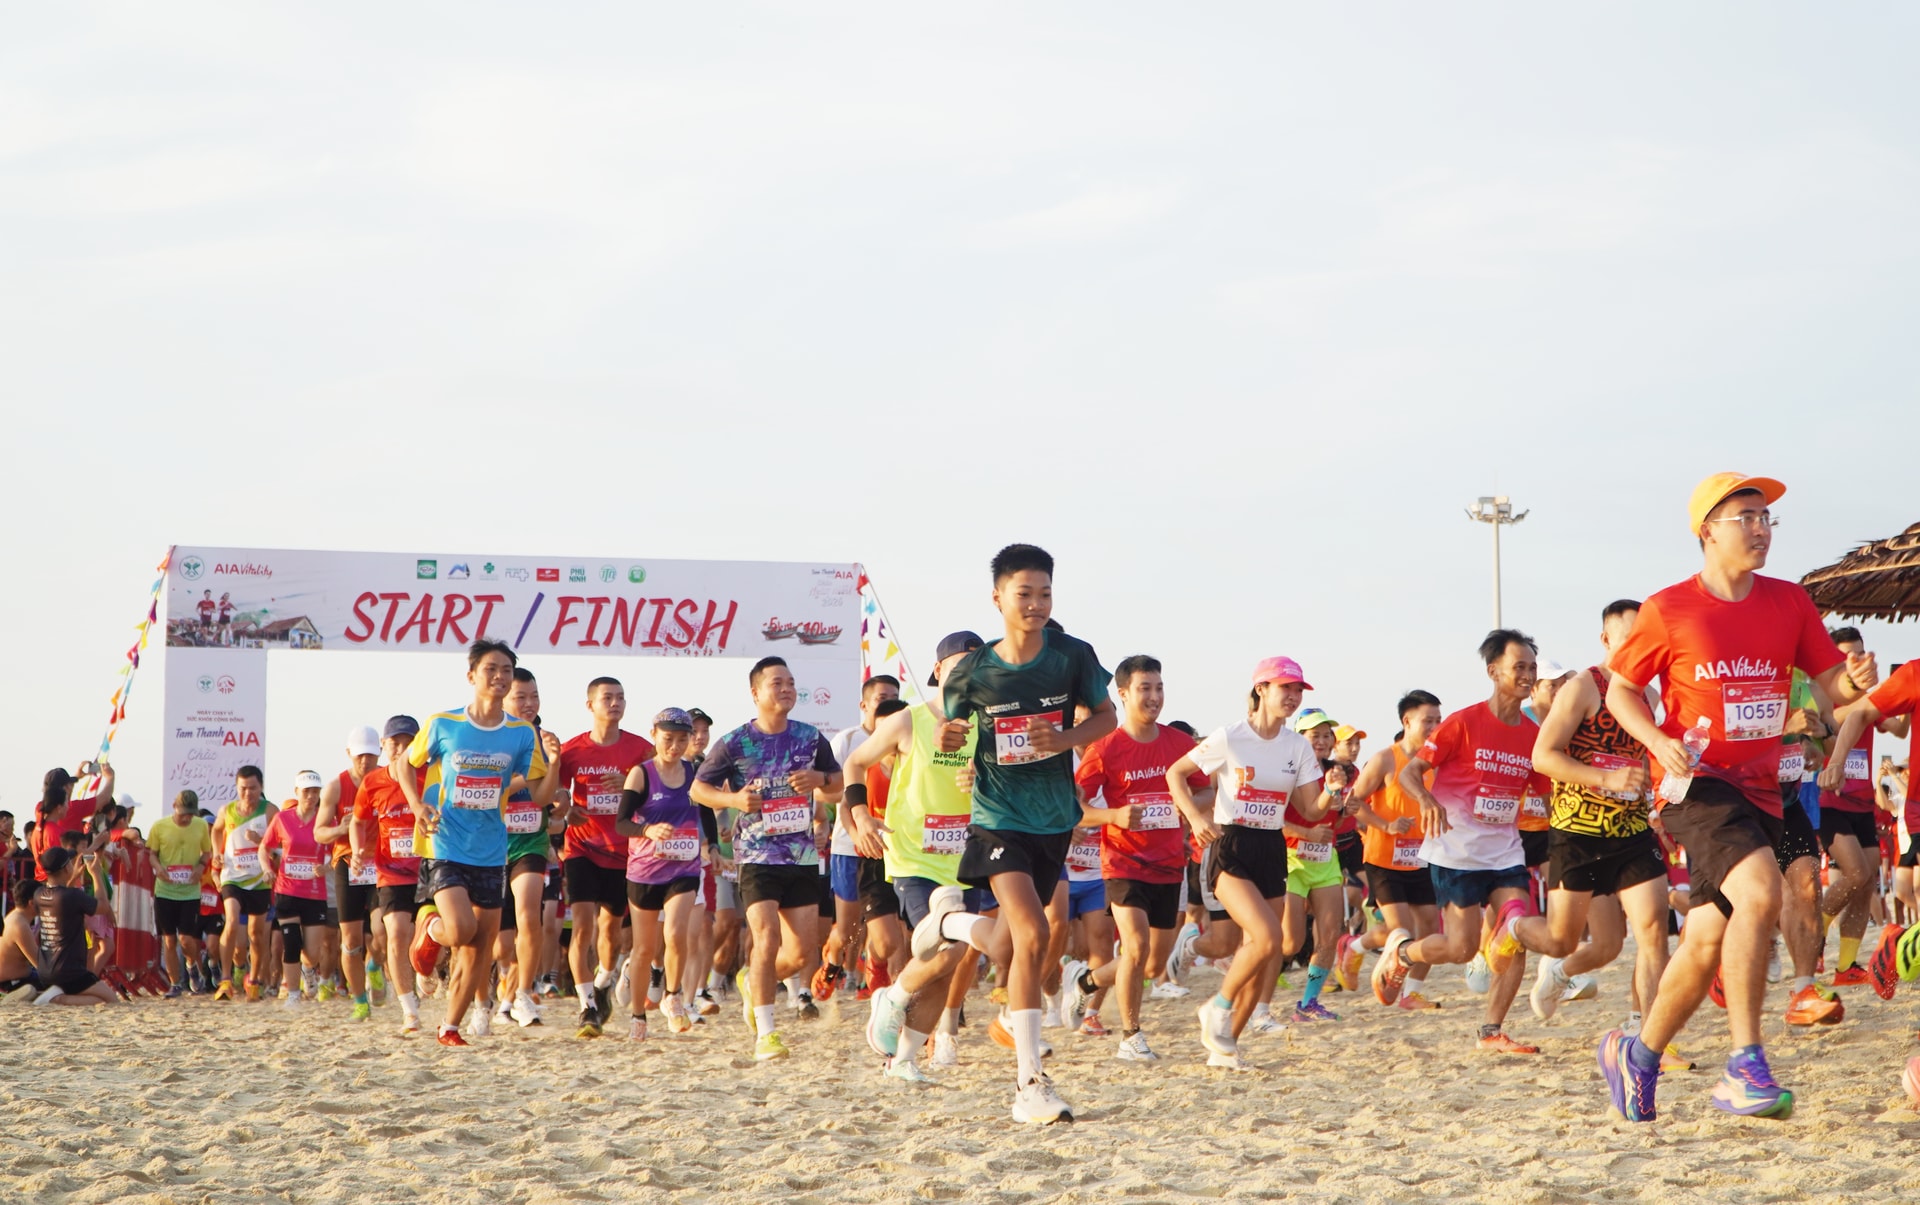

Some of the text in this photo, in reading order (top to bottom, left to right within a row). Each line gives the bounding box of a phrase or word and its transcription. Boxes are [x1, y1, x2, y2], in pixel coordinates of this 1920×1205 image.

[214, 563, 272, 579] AIA Vitality
[834, 571, 854, 579] AIA
[344, 591, 505, 644] START
[549, 596, 738, 650] FINISH
[1695, 656, 1778, 683] AIA Vitality
[1735, 702, 1782, 720] 10557
[175, 728, 193, 738] Tam
[196, 726, 224, 738] Thanh
[222, 731, 260, 747] AIA
[1476, 748, 1495, 760] FLY
[1474, 760, 1498, 773] RUN
[1778, 758, 1802, 770] 0084
[577, 766, 596, 775] AIA
[1124, 770, 1145, 782] AIA
[461, 788, 496, 799] 10052
[592, 795, 623, 805] 1054
[1482, 799, 1515, 812] 10599
[1142, 806, 1173, 818] 0220
[1244, 802, 1277, 817] 10165
[509, 813, 537, 823] 10451
[768, 809, 806, 824] 10424
[394, 839, 413, 848] 100
[662, 840, 695, 850] 10600
[1400, 848, 1420, 857] 104
